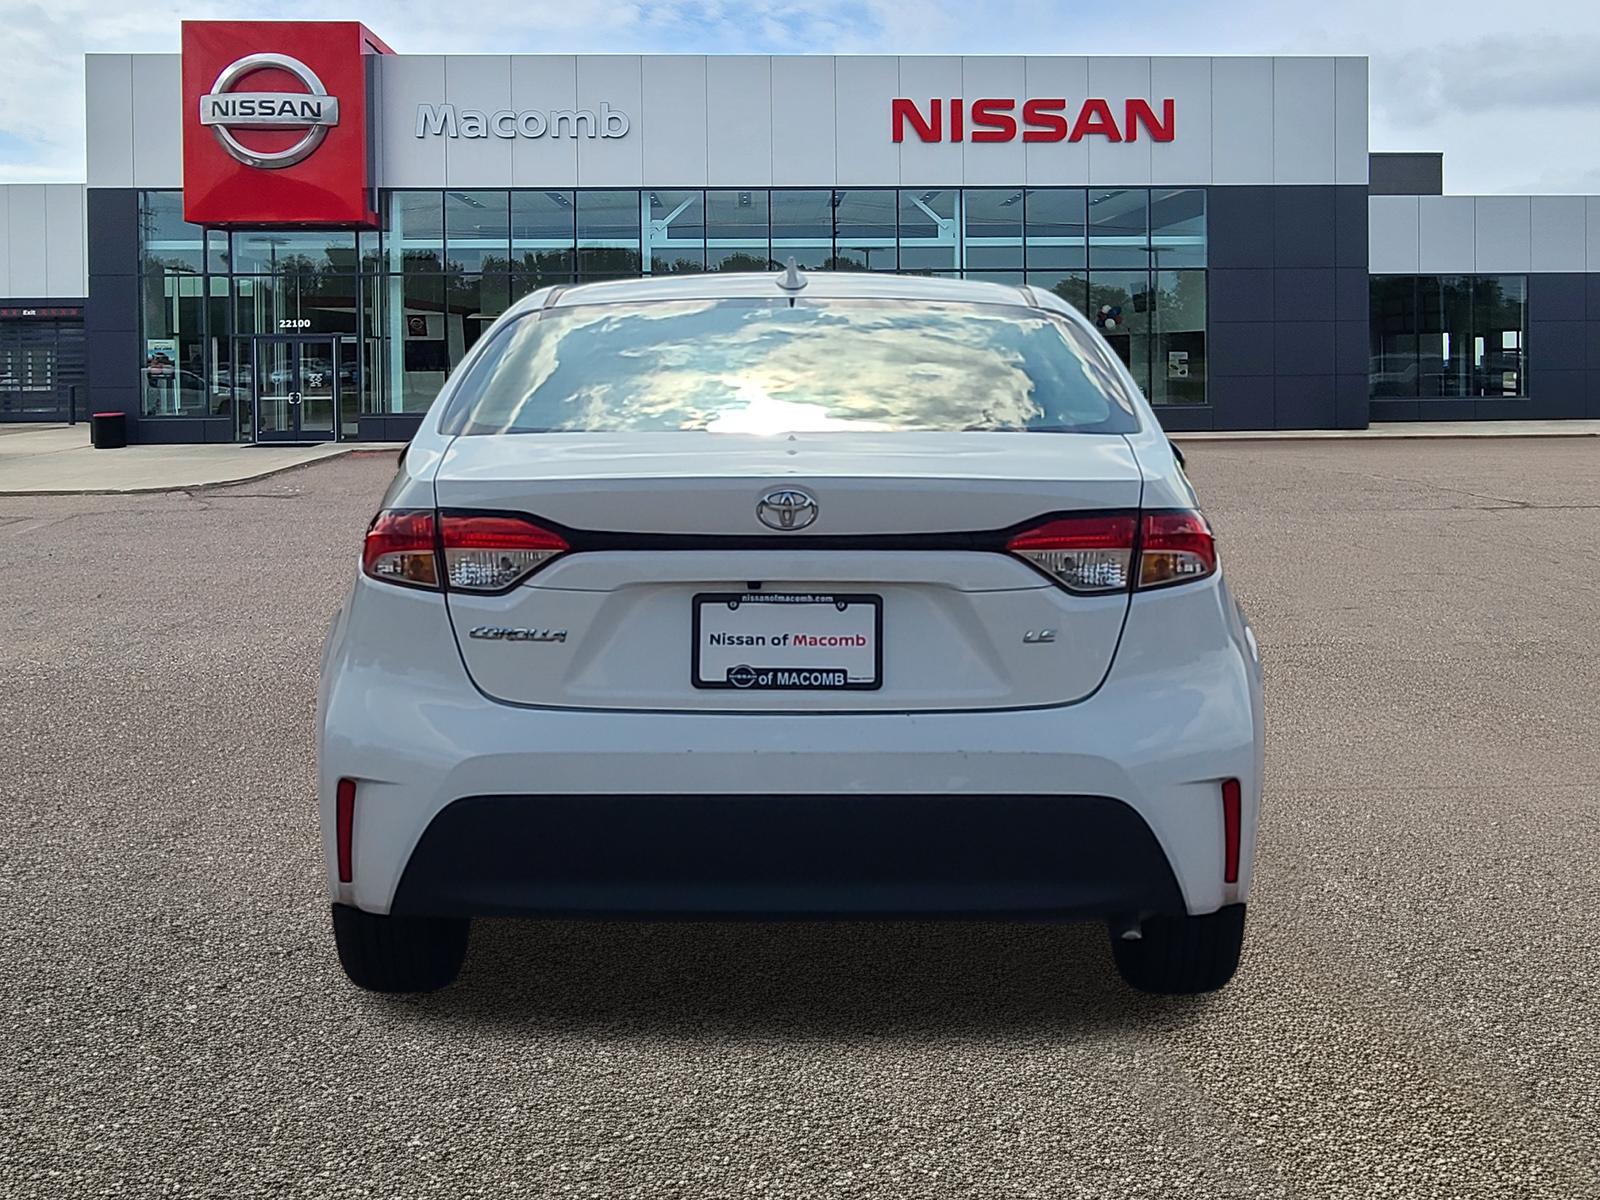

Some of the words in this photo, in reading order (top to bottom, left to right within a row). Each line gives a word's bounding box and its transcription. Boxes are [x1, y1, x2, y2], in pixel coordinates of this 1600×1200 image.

[211, 99, 322, 118] NISSAN
[415, 102, 630, 139] Macomb
[891, 98, 1176, 143] NISSAN
[279, 319, 311, 328] 22100
[469, 627, 567, 643] COROLLA
[709, 632, 766, 646] Nissan
[771, 633, 789, 646] of
[793, 634, 867, 647] Macomb
[1023, 629, 1057, 643] LE
[758, 672, 773, 685] of
[777, 672, 845, 686] MACOMB
